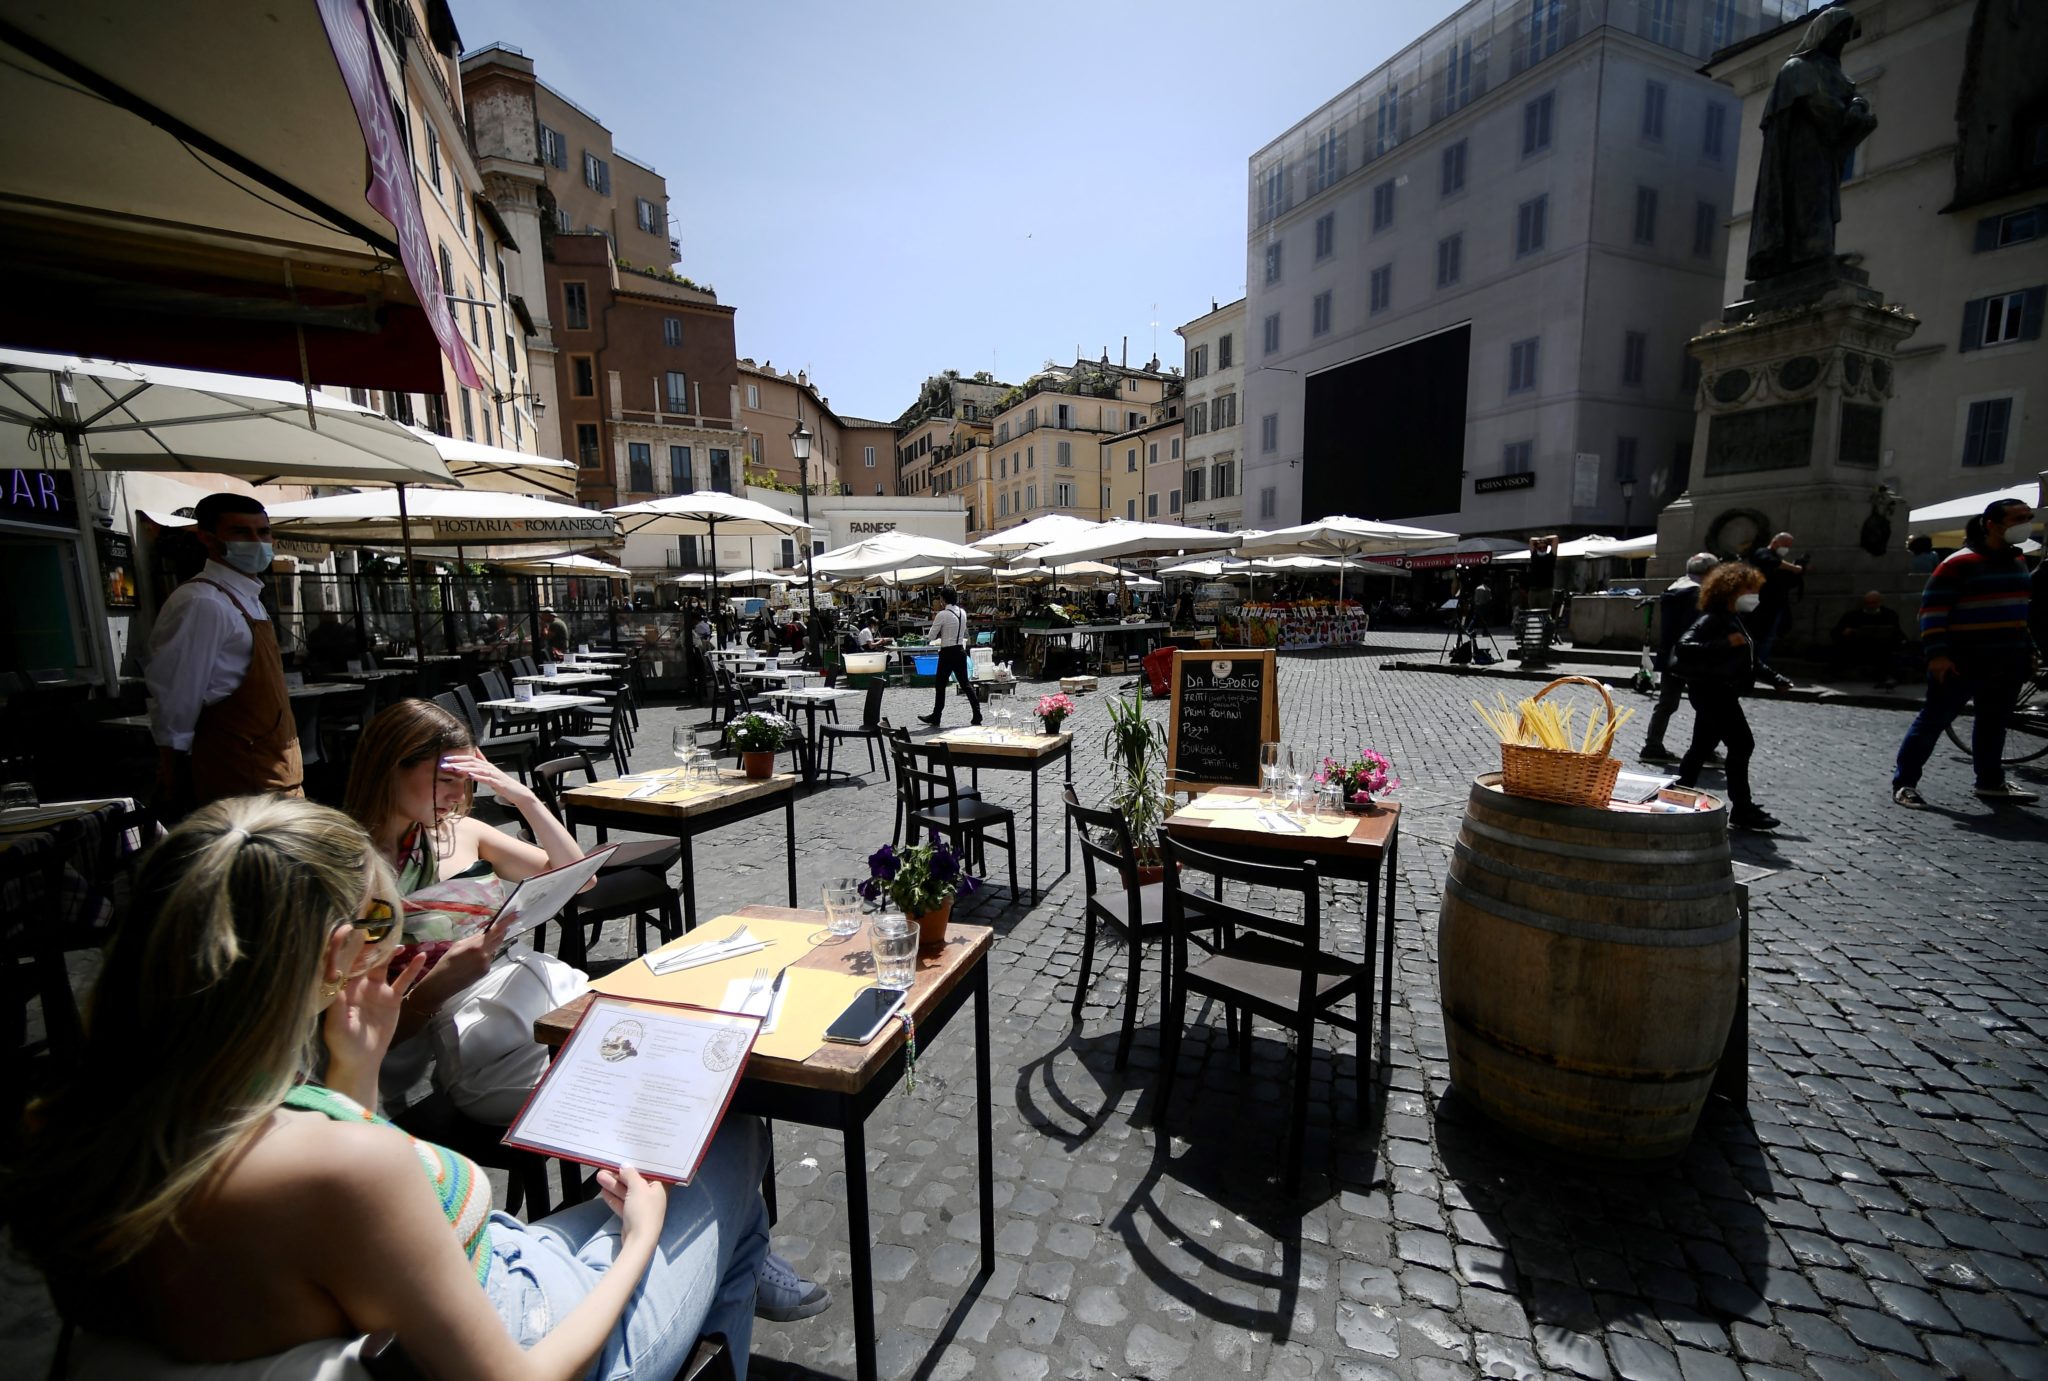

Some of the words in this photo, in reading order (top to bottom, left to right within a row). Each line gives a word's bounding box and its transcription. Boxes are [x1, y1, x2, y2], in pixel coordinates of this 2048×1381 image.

[1503, 475, 1529, 487] VISION
[0, 469, 60, 512] AR
[437, 518, 512, 532] HOSTARIA
[524, 518, 611, 532] ROMANESCA
[1187, 674, 1204, 688] DA
[1211, 674, 1260, 689] ASPORTO
[1183, 705, 1206, 717] PRIMI
[1209, 707, 1242, 719] ROMANI
